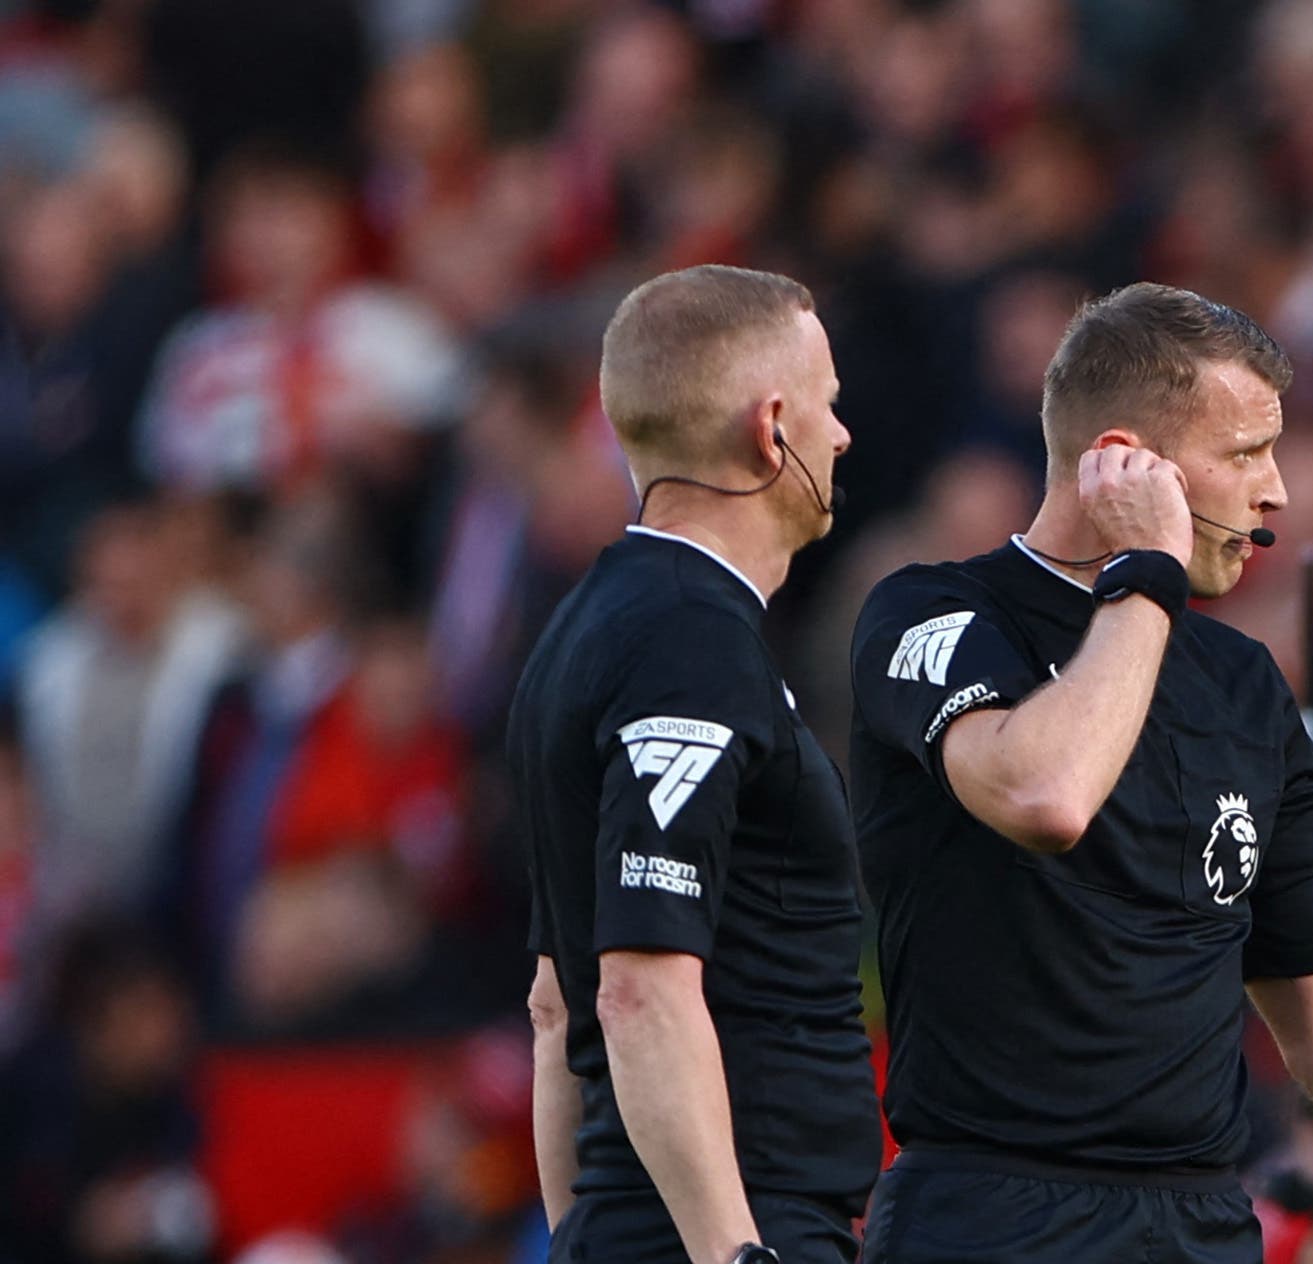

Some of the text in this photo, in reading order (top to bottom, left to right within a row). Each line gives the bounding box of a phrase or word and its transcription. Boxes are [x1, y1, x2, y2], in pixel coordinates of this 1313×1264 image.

[904, 616, 957, 645] SPORTS
[941, 683, 987, 718] room
[656, 721, 716, 740] SPORTS
[626, 740, 723, 831] FC
[621, 851, 697, 880] No room
[645, 872, 702, 898] racism
